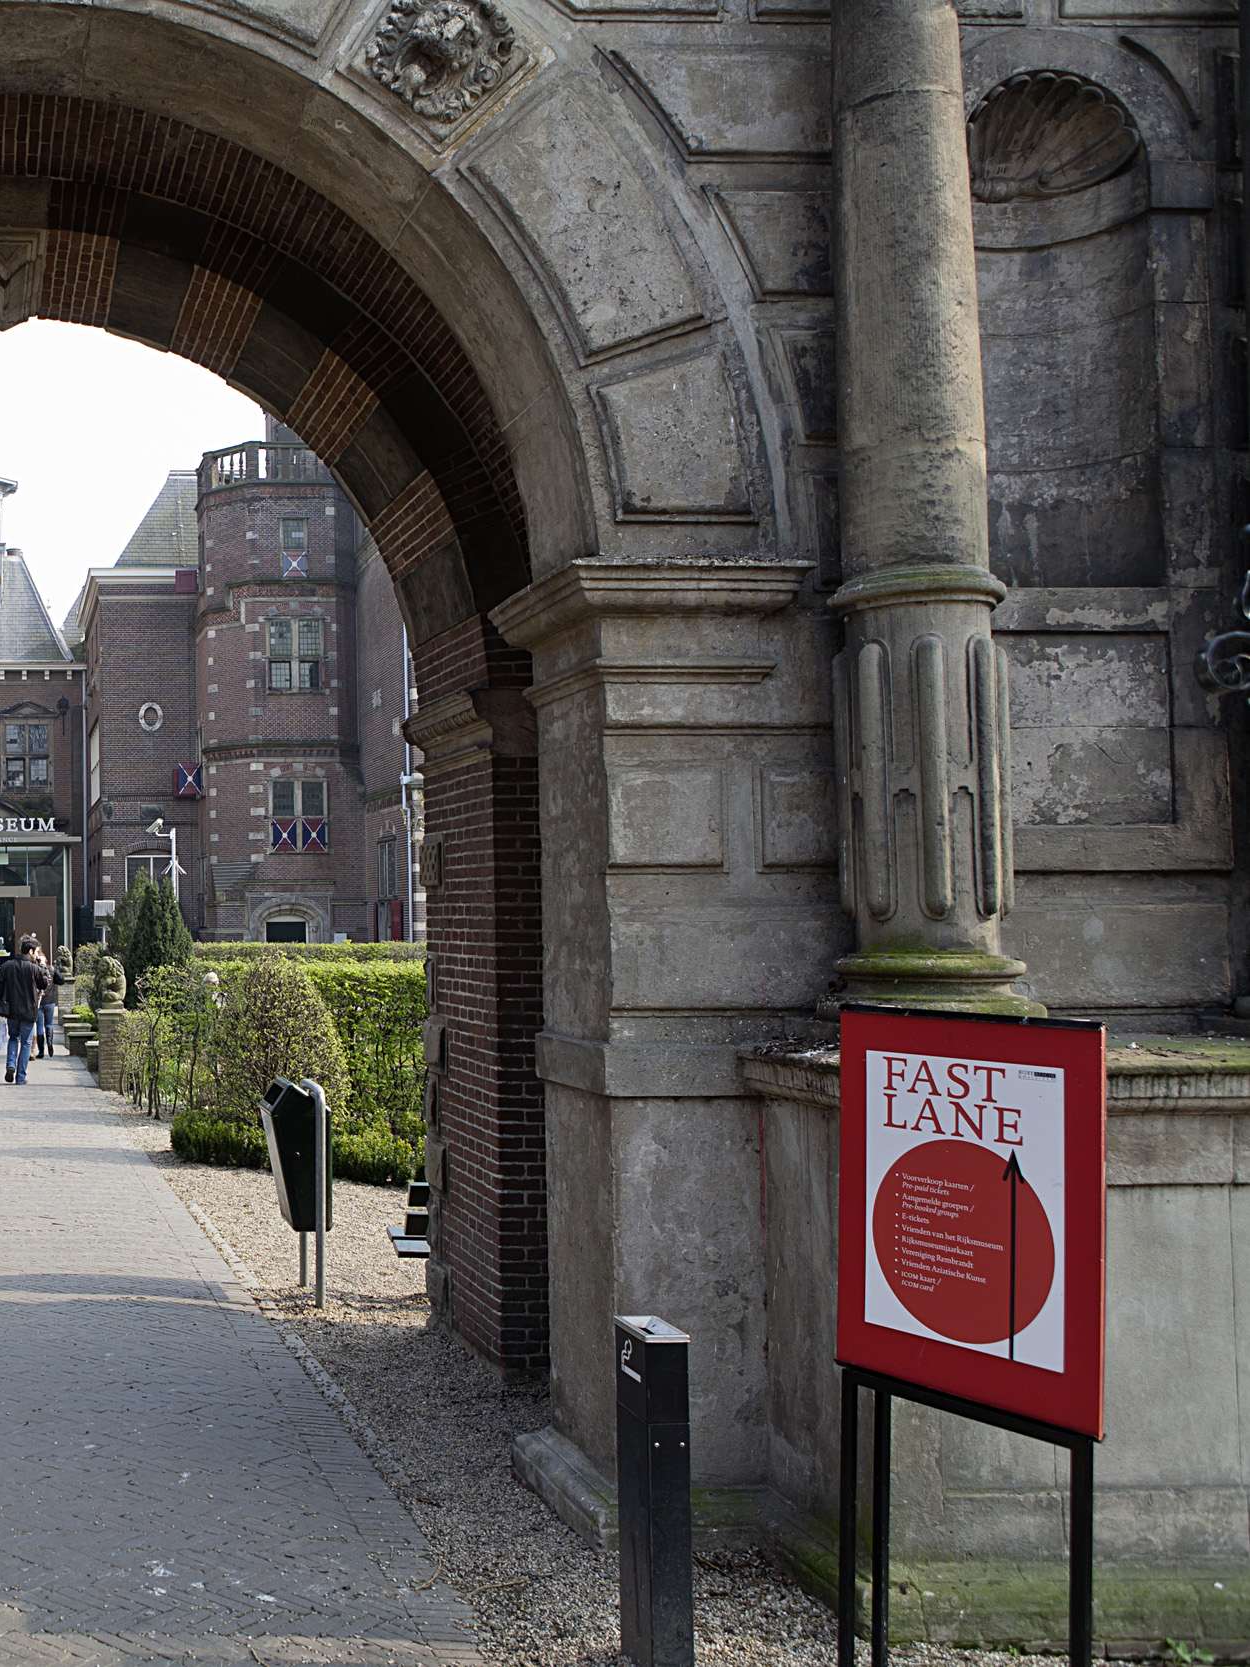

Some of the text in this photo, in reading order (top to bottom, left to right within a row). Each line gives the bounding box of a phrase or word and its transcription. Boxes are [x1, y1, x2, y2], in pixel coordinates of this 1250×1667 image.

[882, 1055, 1007, 1104] FAST
[882, 1092, 1024, 1147] LANE
[901, 1173, 944, 1187] Voorverkoop
[944, 1179, 970, 1191] kaarten
[901, 1182, 950, 1196] Pre-paid tickets
[936, 1209, 959, 1220] groups
[941, 1202, 969, 1213] groepen
[901, 1212, 930, 1224] E-tickets
[901, 1224, 1004, 1251] Vrienden van het Rijksmuseum
[901, 1247, 974, 1269] Vereniging Rembrandt
[901, 1258, 987, 1284] Vrienden Aziatische Kunst
[901, 1271, 919, 1281] ICOM
[919, 1274, 936, 1285] kaart
[901, 1280, 935, 1292] ICOM card
